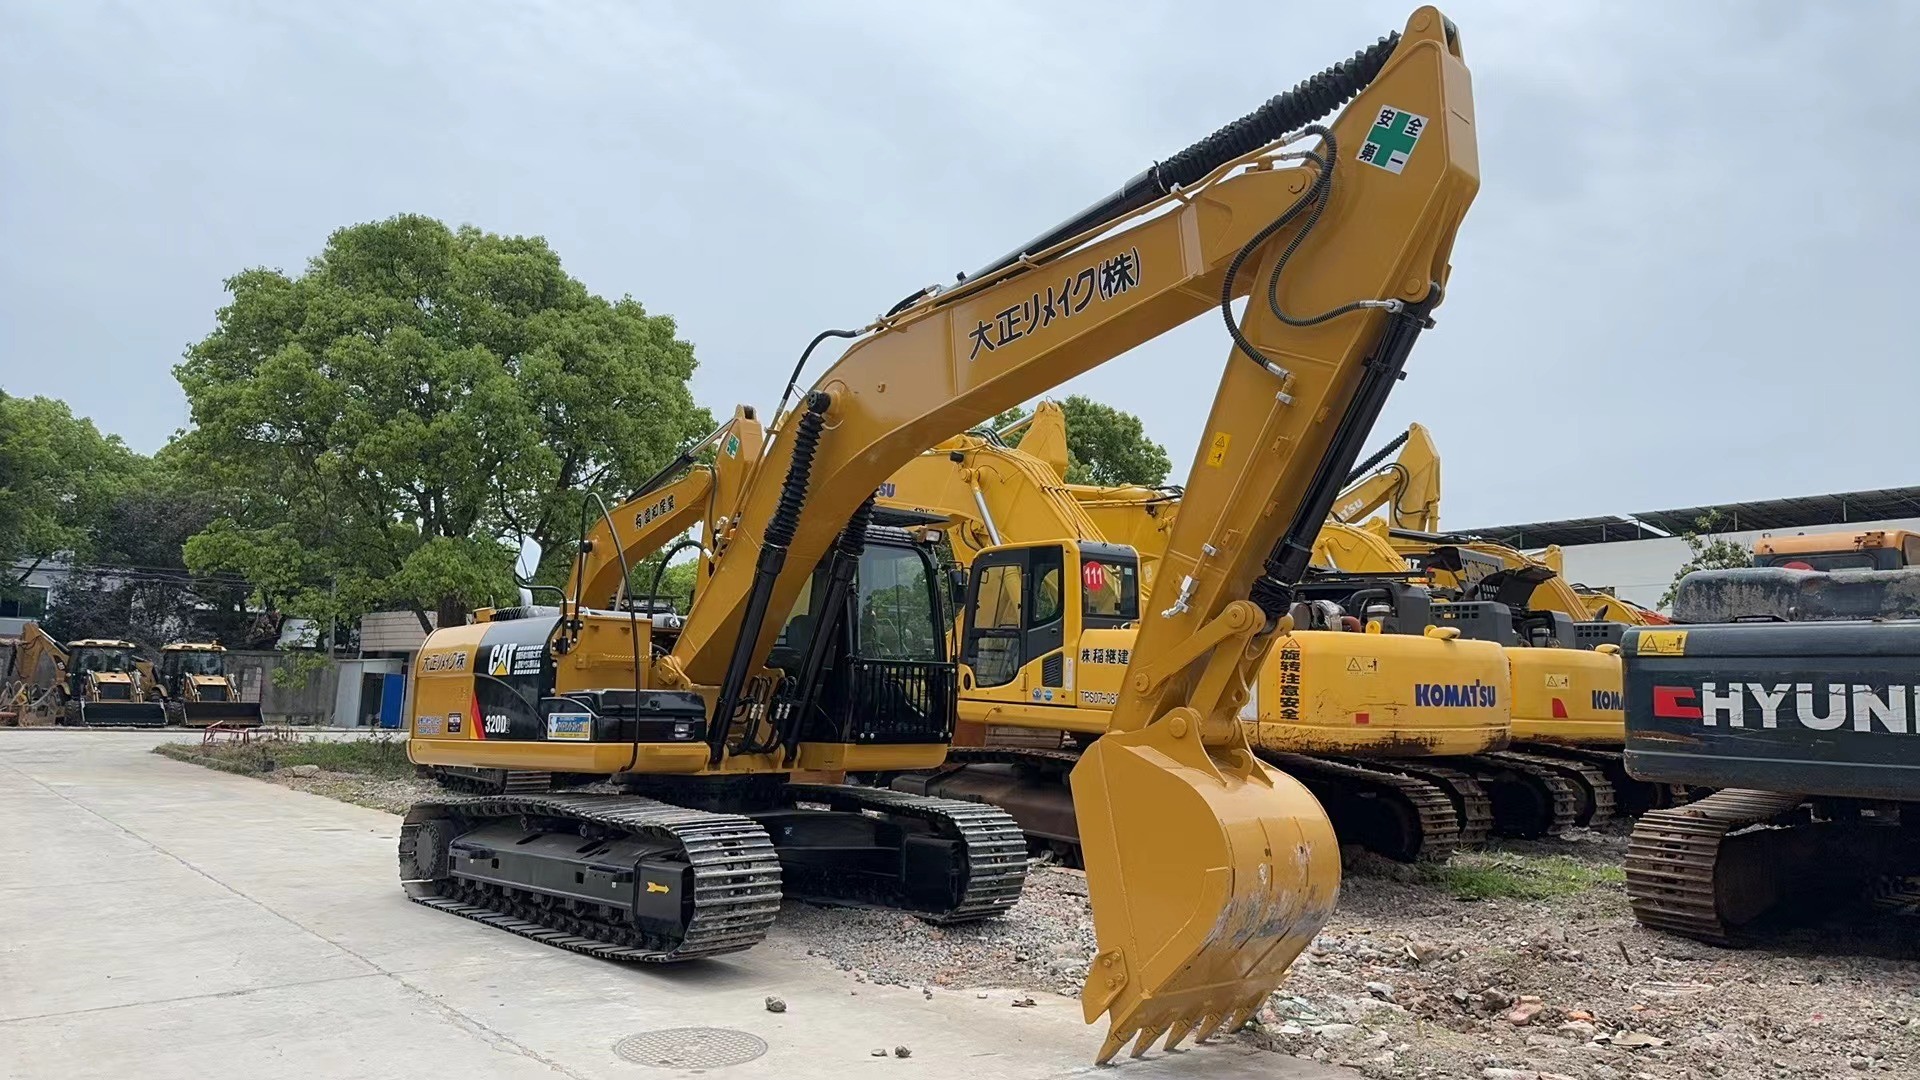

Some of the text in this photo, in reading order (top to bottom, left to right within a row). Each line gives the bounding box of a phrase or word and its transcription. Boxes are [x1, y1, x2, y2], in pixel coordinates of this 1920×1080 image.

[1085, 566, 1103, 585] 111
[488, 643, 518, 676] CAT
[1081, 648, 1131, 665] 株稲継建
[1280, 649, 1301, 720] 旋转注意安全
[1415, 679, 1496, 708] KOMATSU
[1080, 690, 1120, 705] TPS07-08
[1592, 689, 1624, 710] KOM
[1702, 682, 1920, 734] HYUN
